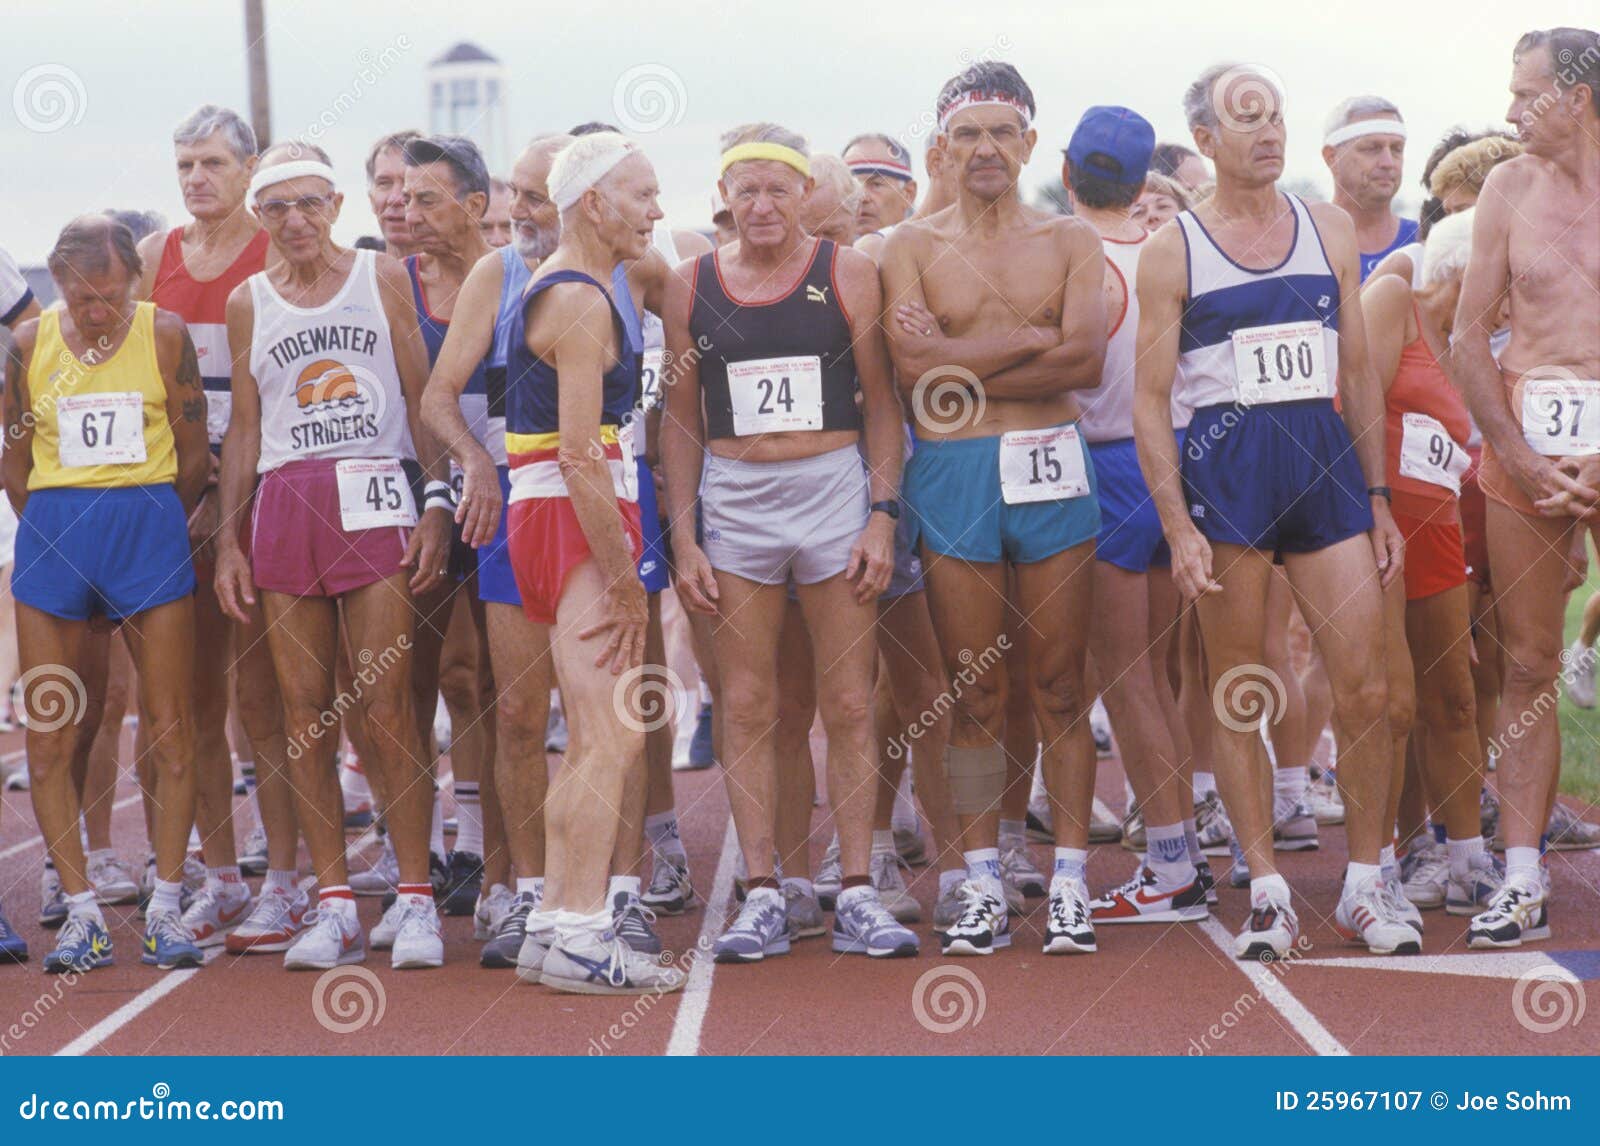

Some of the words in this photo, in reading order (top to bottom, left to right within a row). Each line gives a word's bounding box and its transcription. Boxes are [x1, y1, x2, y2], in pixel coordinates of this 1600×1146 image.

[268, 325, 378, 369] TIDEWATER
[1252, 340, 1313, 384] 100
[757, 376, 795, 415] 24
[81, 411, 116, 448] 67
[290, 413, 380, 450] STRIDERS
[1546, 399, 1585, 437] 37
[1028, 446, 1062, 484] 15
[366, 476, 402, 511] 45
